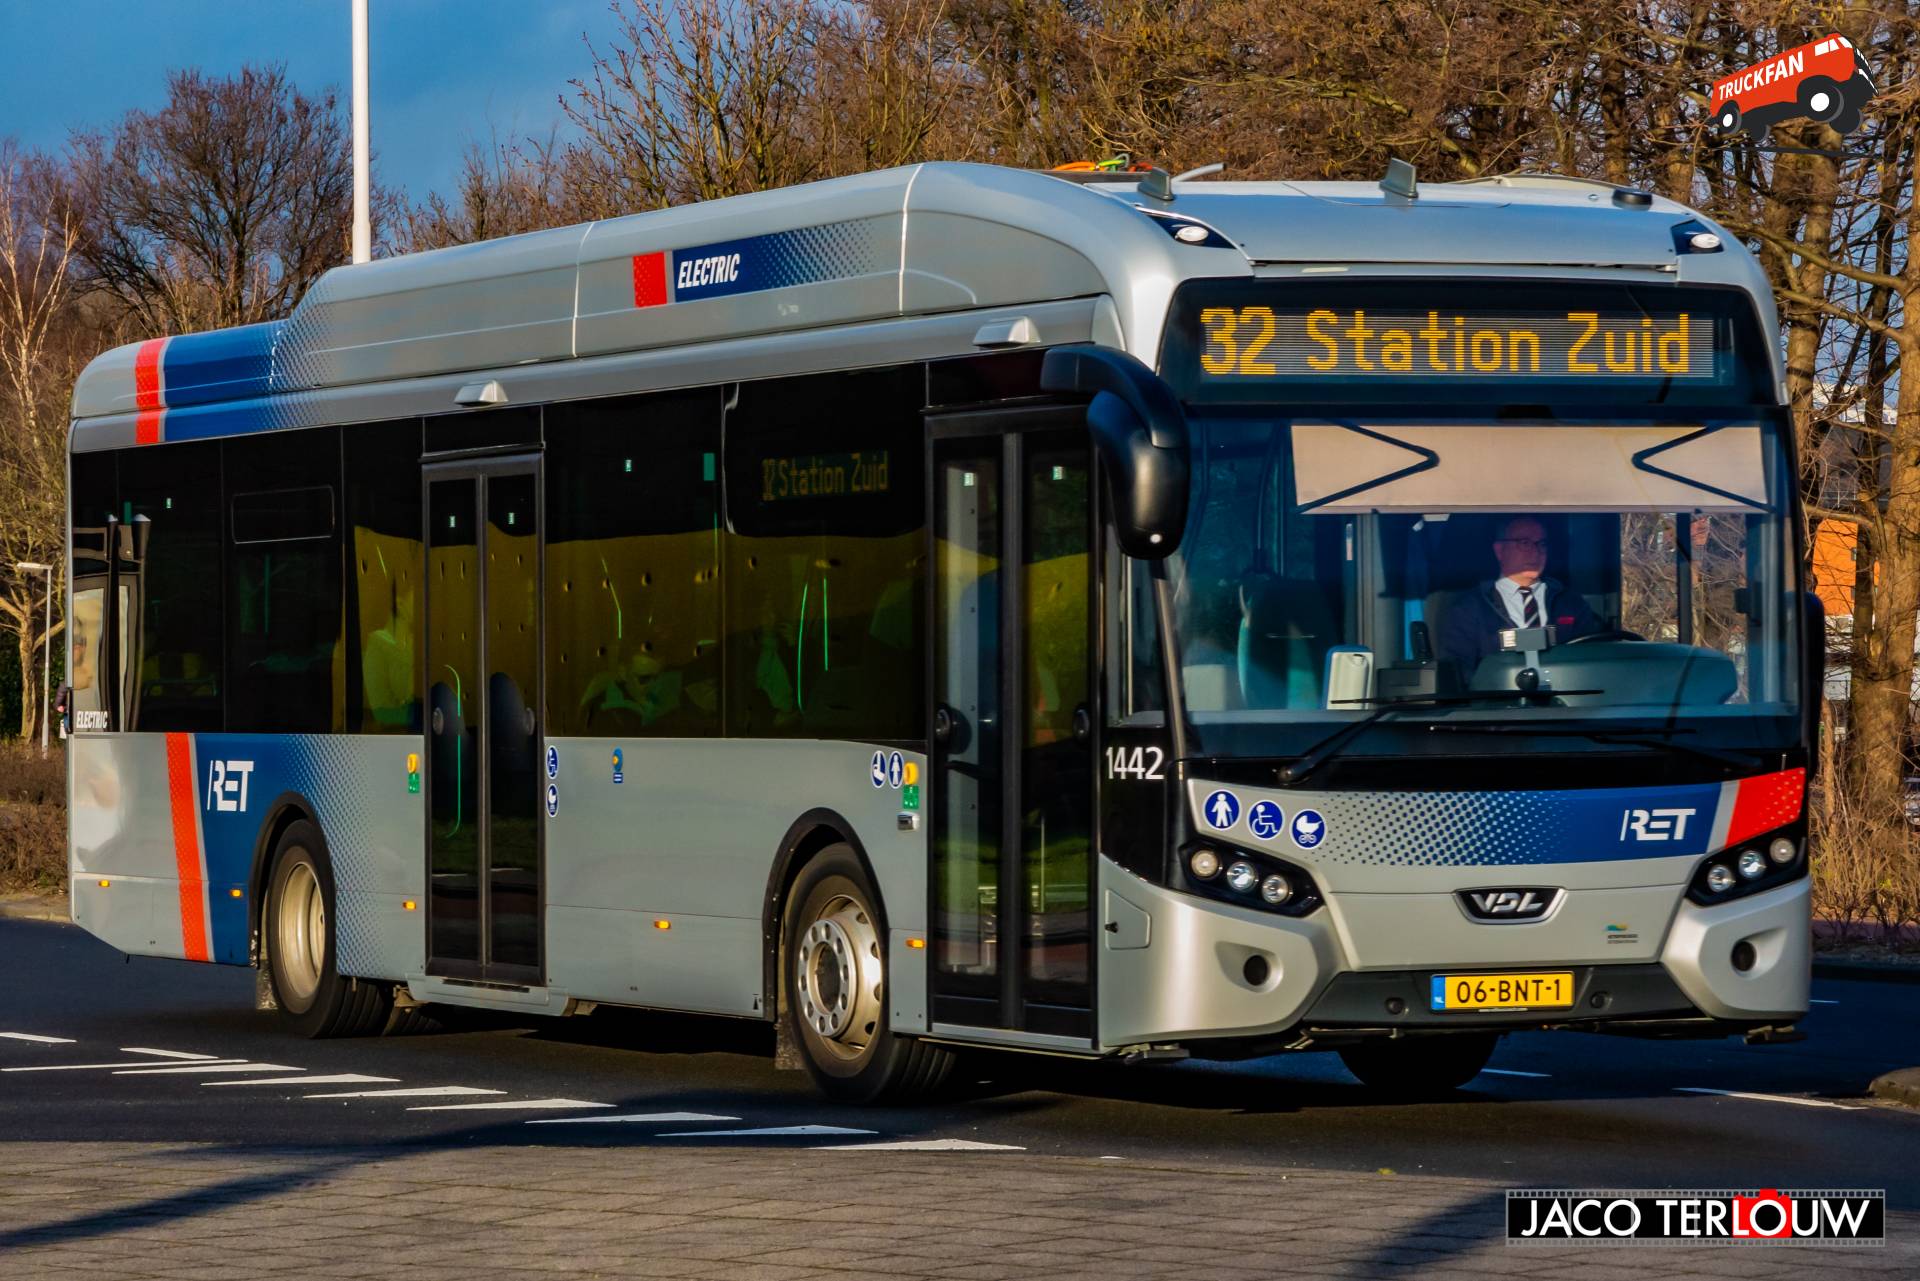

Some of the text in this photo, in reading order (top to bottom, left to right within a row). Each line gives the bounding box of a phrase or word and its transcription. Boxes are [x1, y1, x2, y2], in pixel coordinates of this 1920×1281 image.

[678, 253, 741, 289] ELECTRIC
[1201, 306, 1689, 375] 32 Station Zuid
[778, 456, 845, 497] Station
[851, 450, 889, 493] Zuid
[76, 710, 108, 729] ELECTRIC
[1105, 746, 1164, 780] 1442
[207, 760, 254, 812] RET
[1619, 808, 1696, 841] RET
[1470, 892, 1544, 913] VDL
[1456, 978, 1561, 1004] 06-BNT-1
